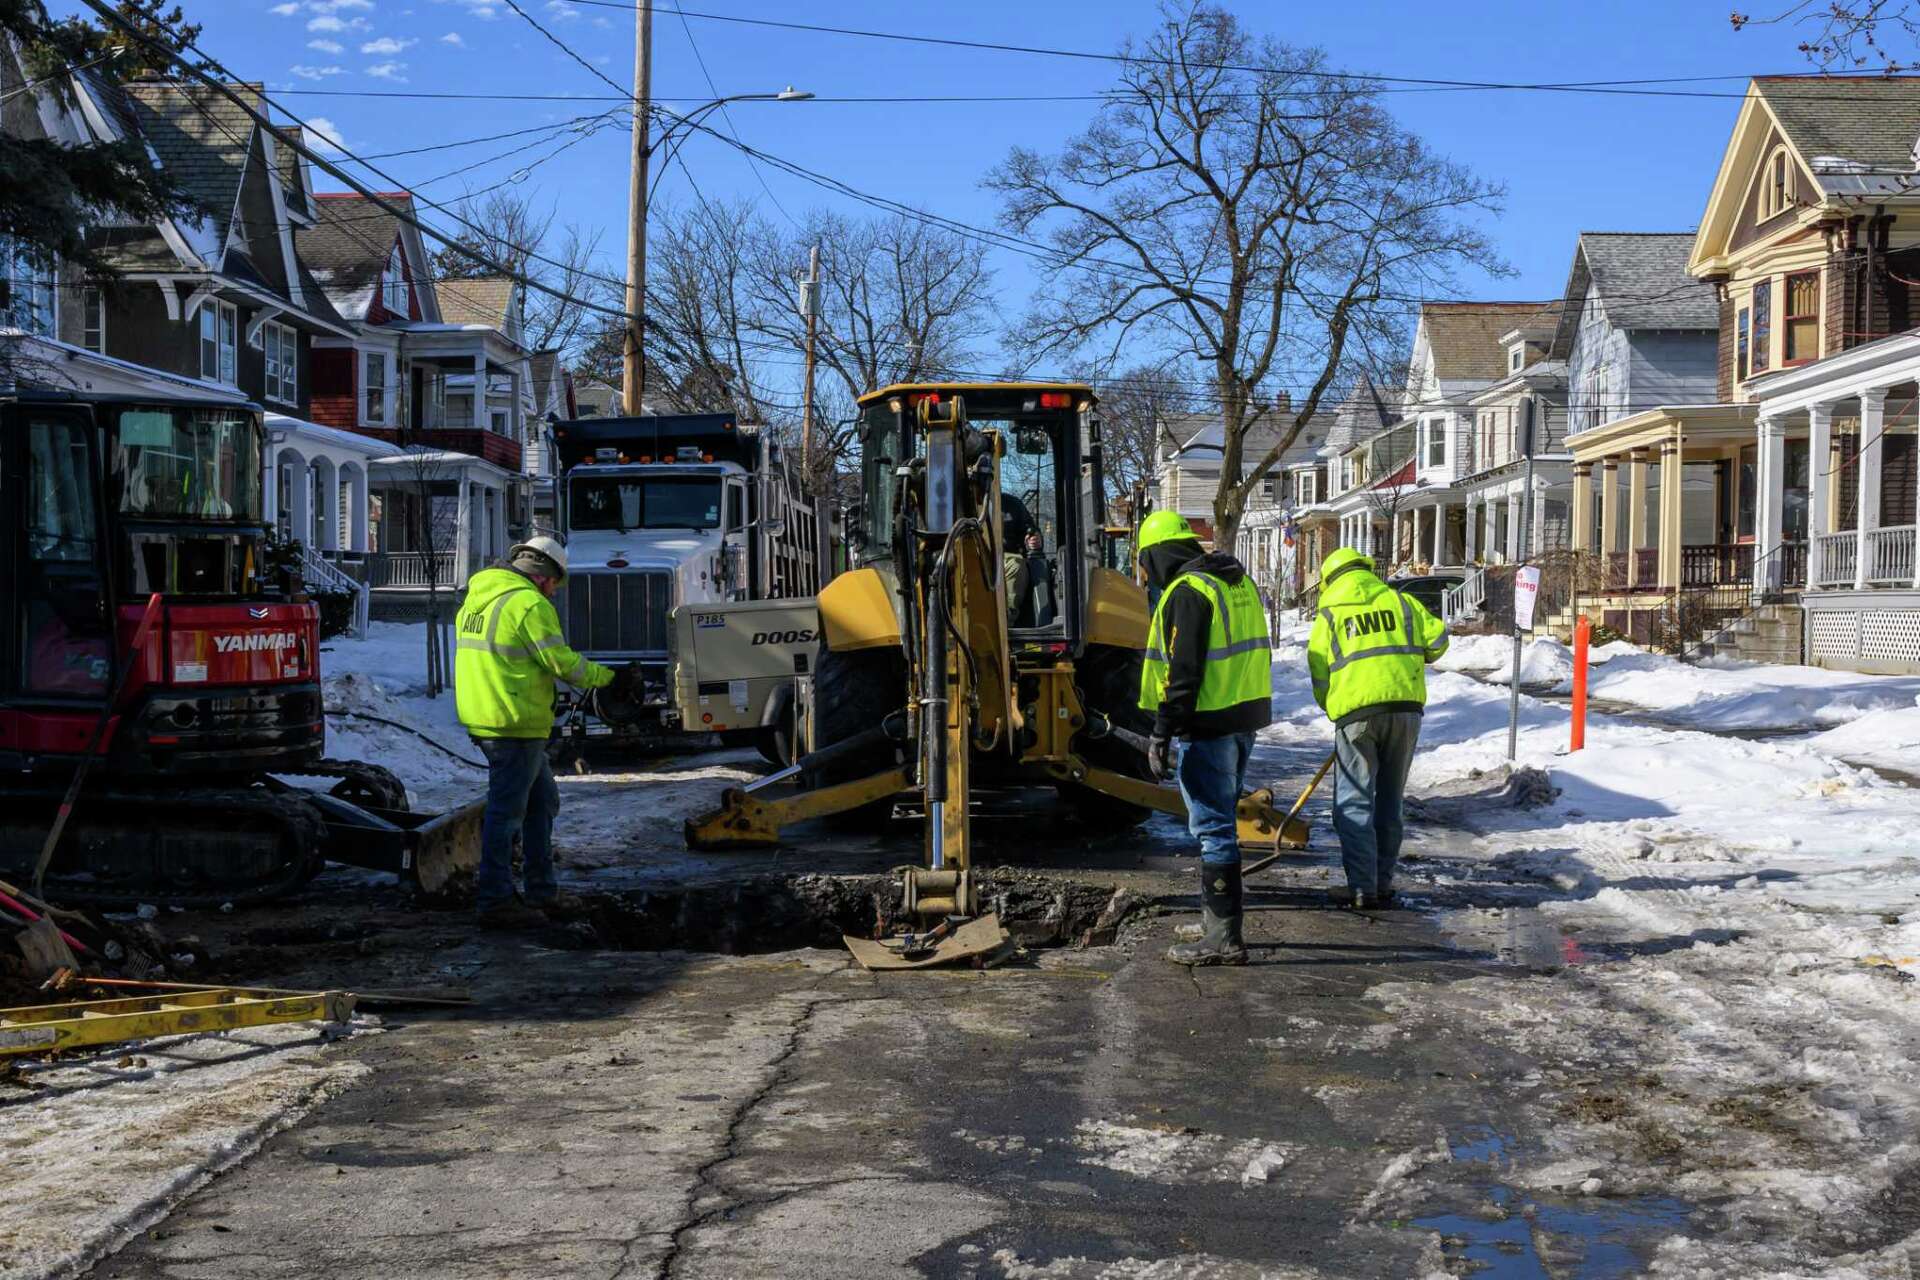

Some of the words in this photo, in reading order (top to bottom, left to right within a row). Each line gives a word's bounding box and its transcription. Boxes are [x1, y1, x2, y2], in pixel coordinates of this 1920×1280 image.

[697, 614, 725, 625] P185
[1343, 609, 1396, 641] AWD
[214, 632, 297, 652] YANMAR
